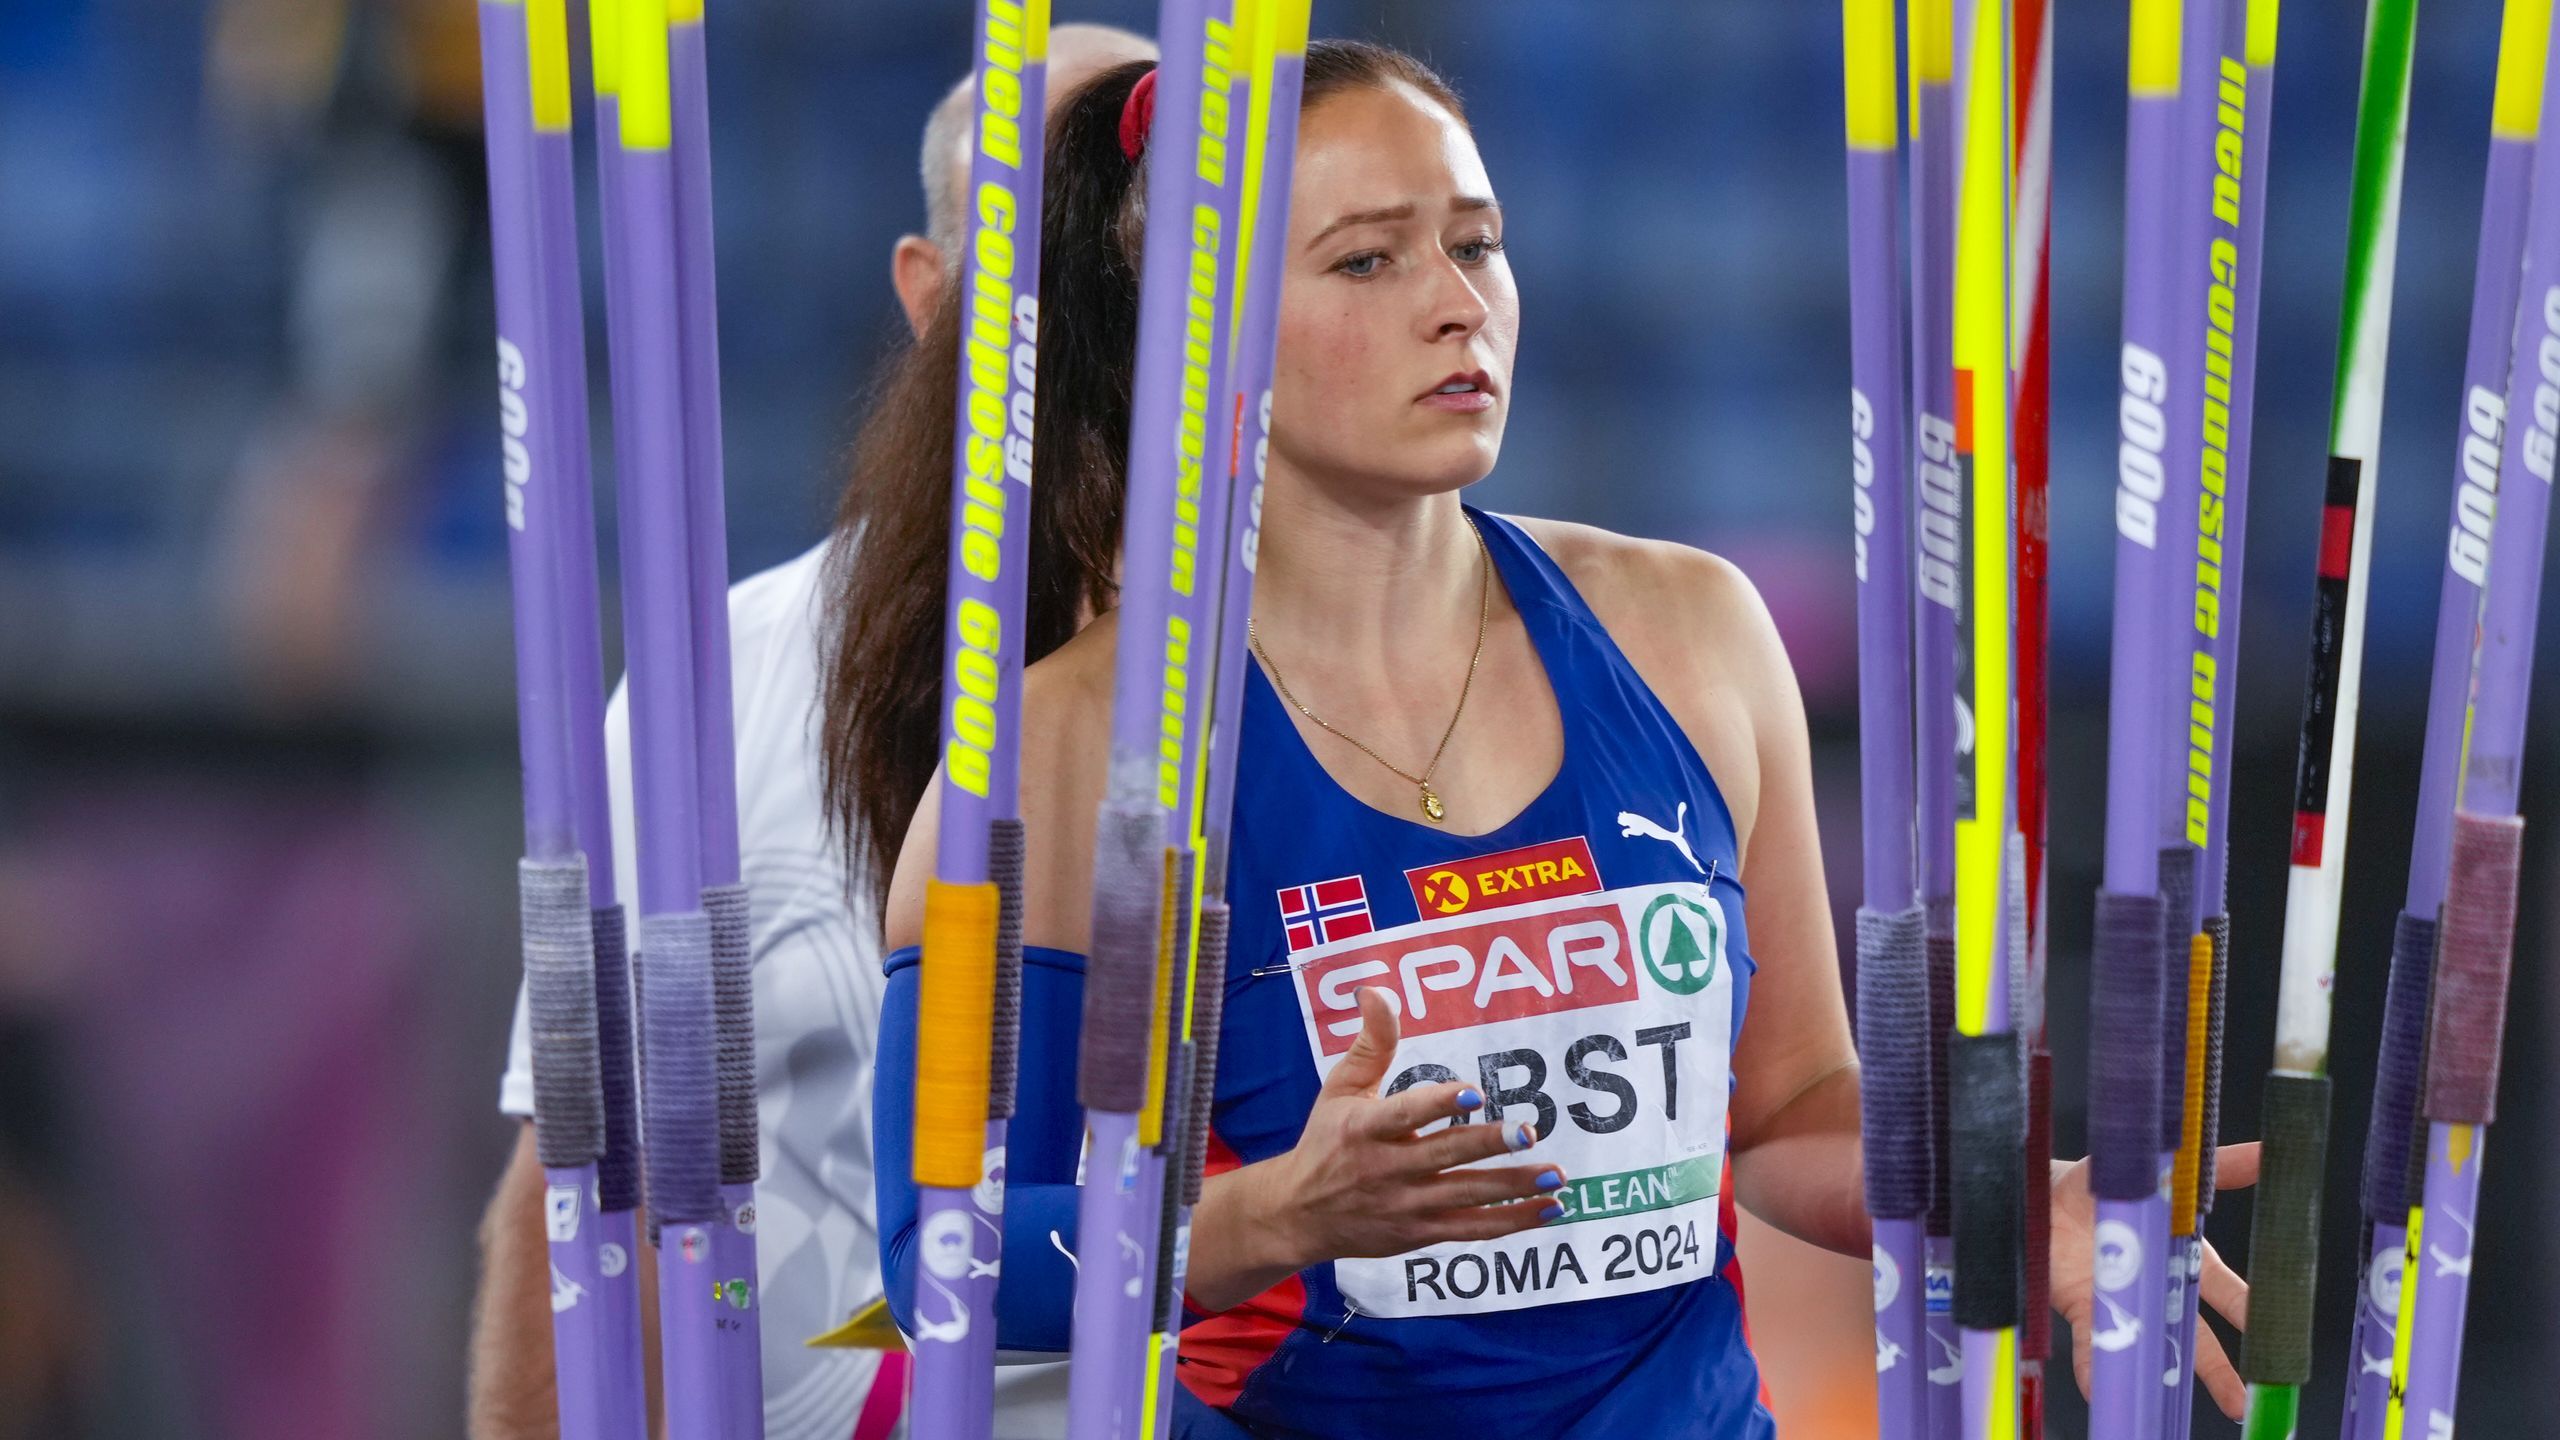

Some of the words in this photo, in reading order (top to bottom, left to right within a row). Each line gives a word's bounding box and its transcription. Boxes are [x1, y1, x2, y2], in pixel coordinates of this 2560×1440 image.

[981, 0, 1026, 170] med
[960, 181, 1017, 583] composite
[2116, 341, 2167, 550] 600g
[2450, 384, 2506, 588] 600g
[946, 597, 1001, 799] 600g
[1476, 856, 1586, 897] EXTRA
[1318, 920, 1628, 1037] SPAR
[1405, 1243, 1588, 1303] ROMA
[1601, 1220, 1700, 1282] 2024
